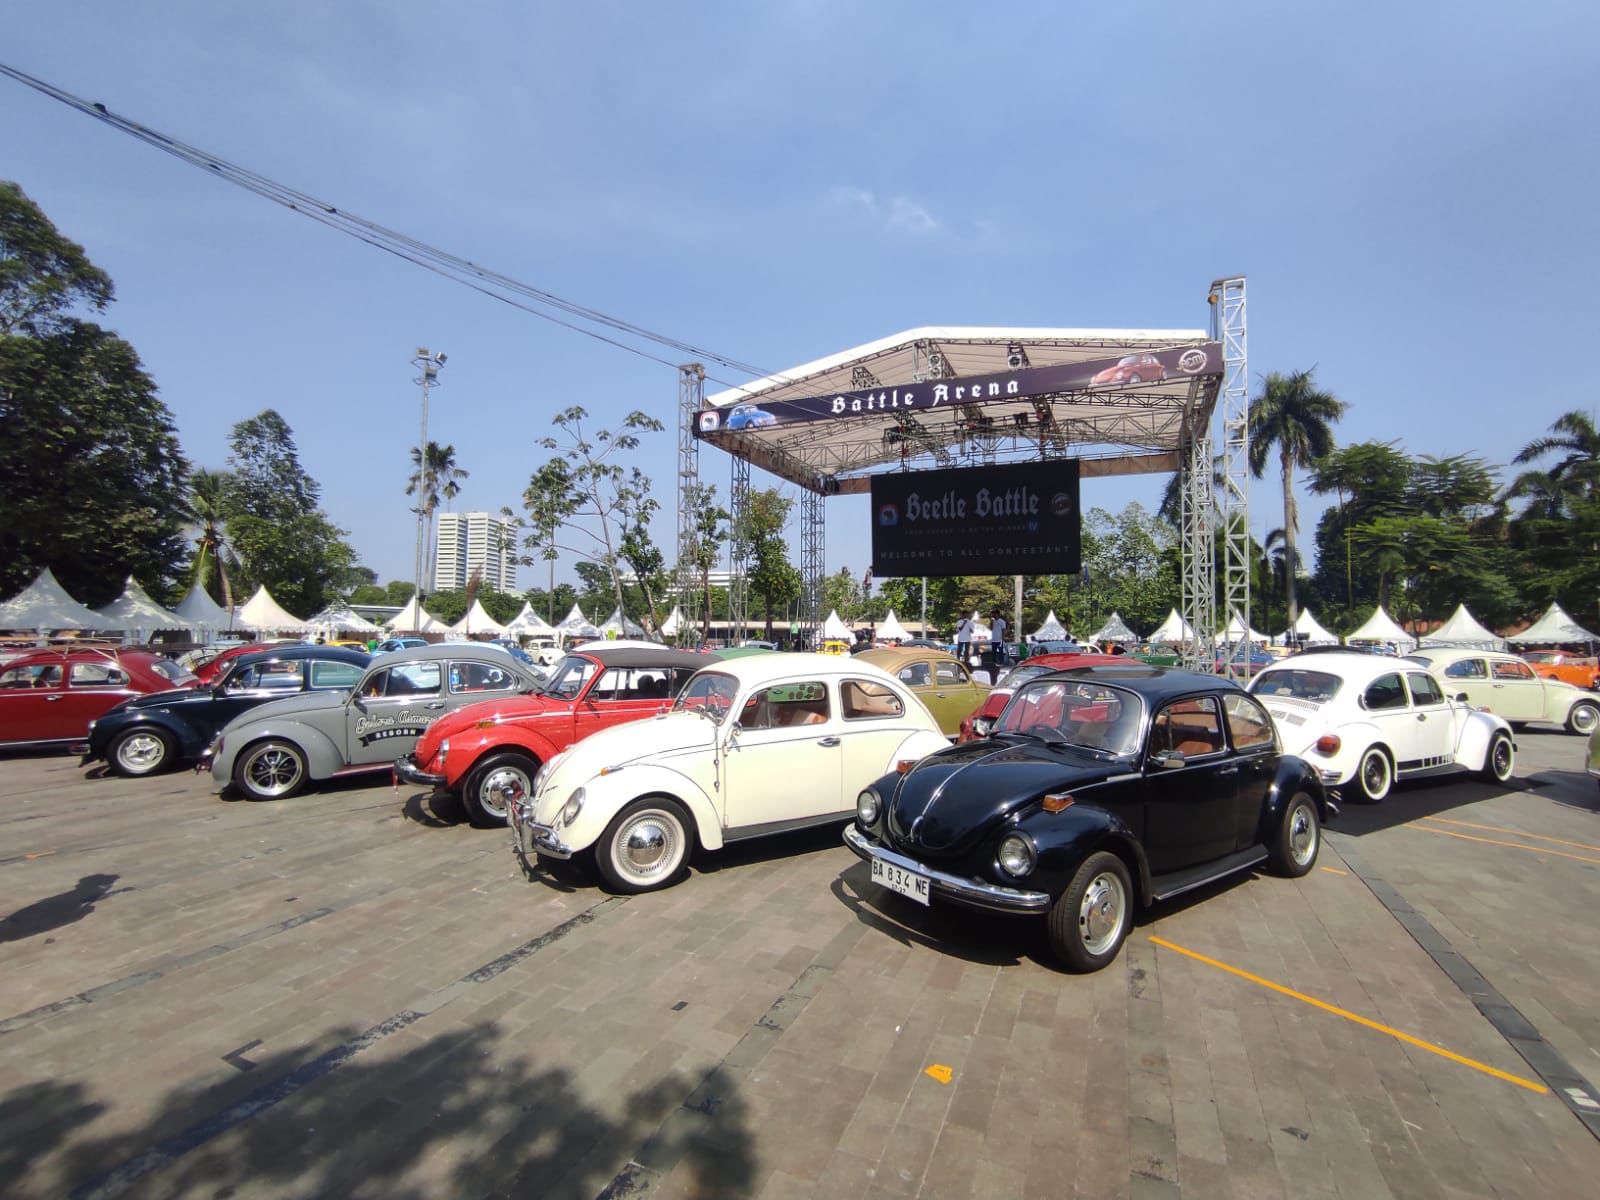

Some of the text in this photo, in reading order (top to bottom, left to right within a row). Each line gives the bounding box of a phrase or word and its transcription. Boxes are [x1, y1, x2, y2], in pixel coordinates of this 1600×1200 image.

[831, 379, 1018, 414] Battle Arena
[905, 485, 1040, 521] Beetle Battle
[881, 545, 1069, 560] WELCOME TO ALL CONTESTANT
[375, 729, 417, 739] REBORN
[873, 860, 928, 896] BA 834 NE
